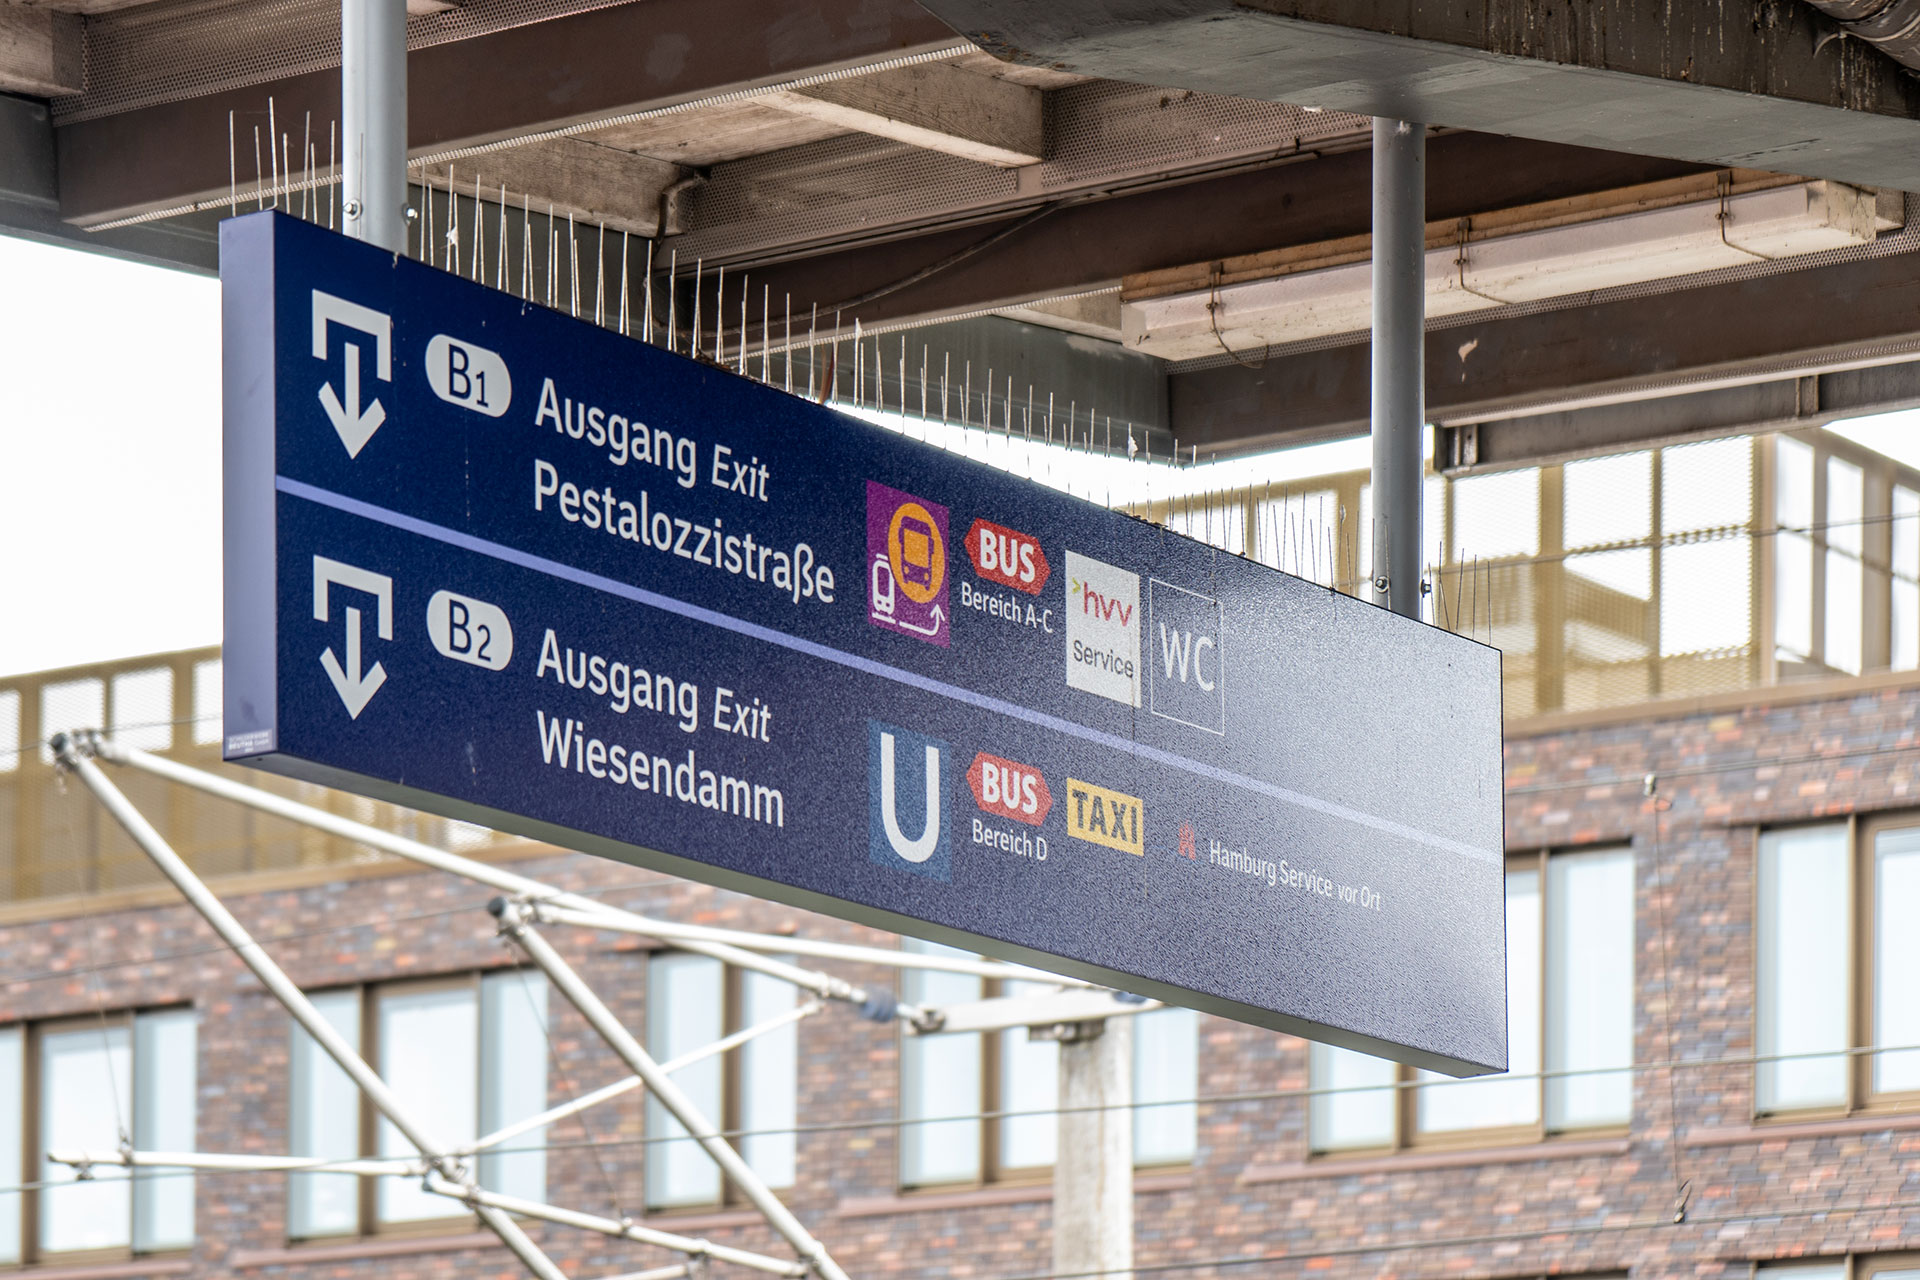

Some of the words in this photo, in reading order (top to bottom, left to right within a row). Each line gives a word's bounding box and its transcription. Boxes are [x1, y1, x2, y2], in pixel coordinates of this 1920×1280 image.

[448, 343, 489, 408] B1
[535, 378, 697, 488] Ausgang
[712, 446, 770, 502] Exit
[535, 459, 835, 604] Pestalozzistraße
[979, 528, 1036, 584] BUS
[448, 598, 492, 663] B2
[962, 582, 1021, 624] Bereich
[1025, 608, 1053, 634] A-C
[536, 629, 698, 732] Ausgang
[714, 688, 772, 742] Exit
[1073, 640, 1134, 678] Service
[1160, 622, 1216, 692] WC
[537, 710, 784, 827] Wiesendamm
[881, 732, 940, 863] U
[982, 761, 1038, 814] BUS
[973, 818, 1032, 858] Bereich
[1036, 837, 1047, 861] D
[1072, 789, 1138, 844] TAXI
[1210, 839, 1276, 886] Hamburg
[1280, 860, 1332, 897] Service
[1338, 884, 1358, 903] vor
[1361, 886, 1381, 911] Ort
